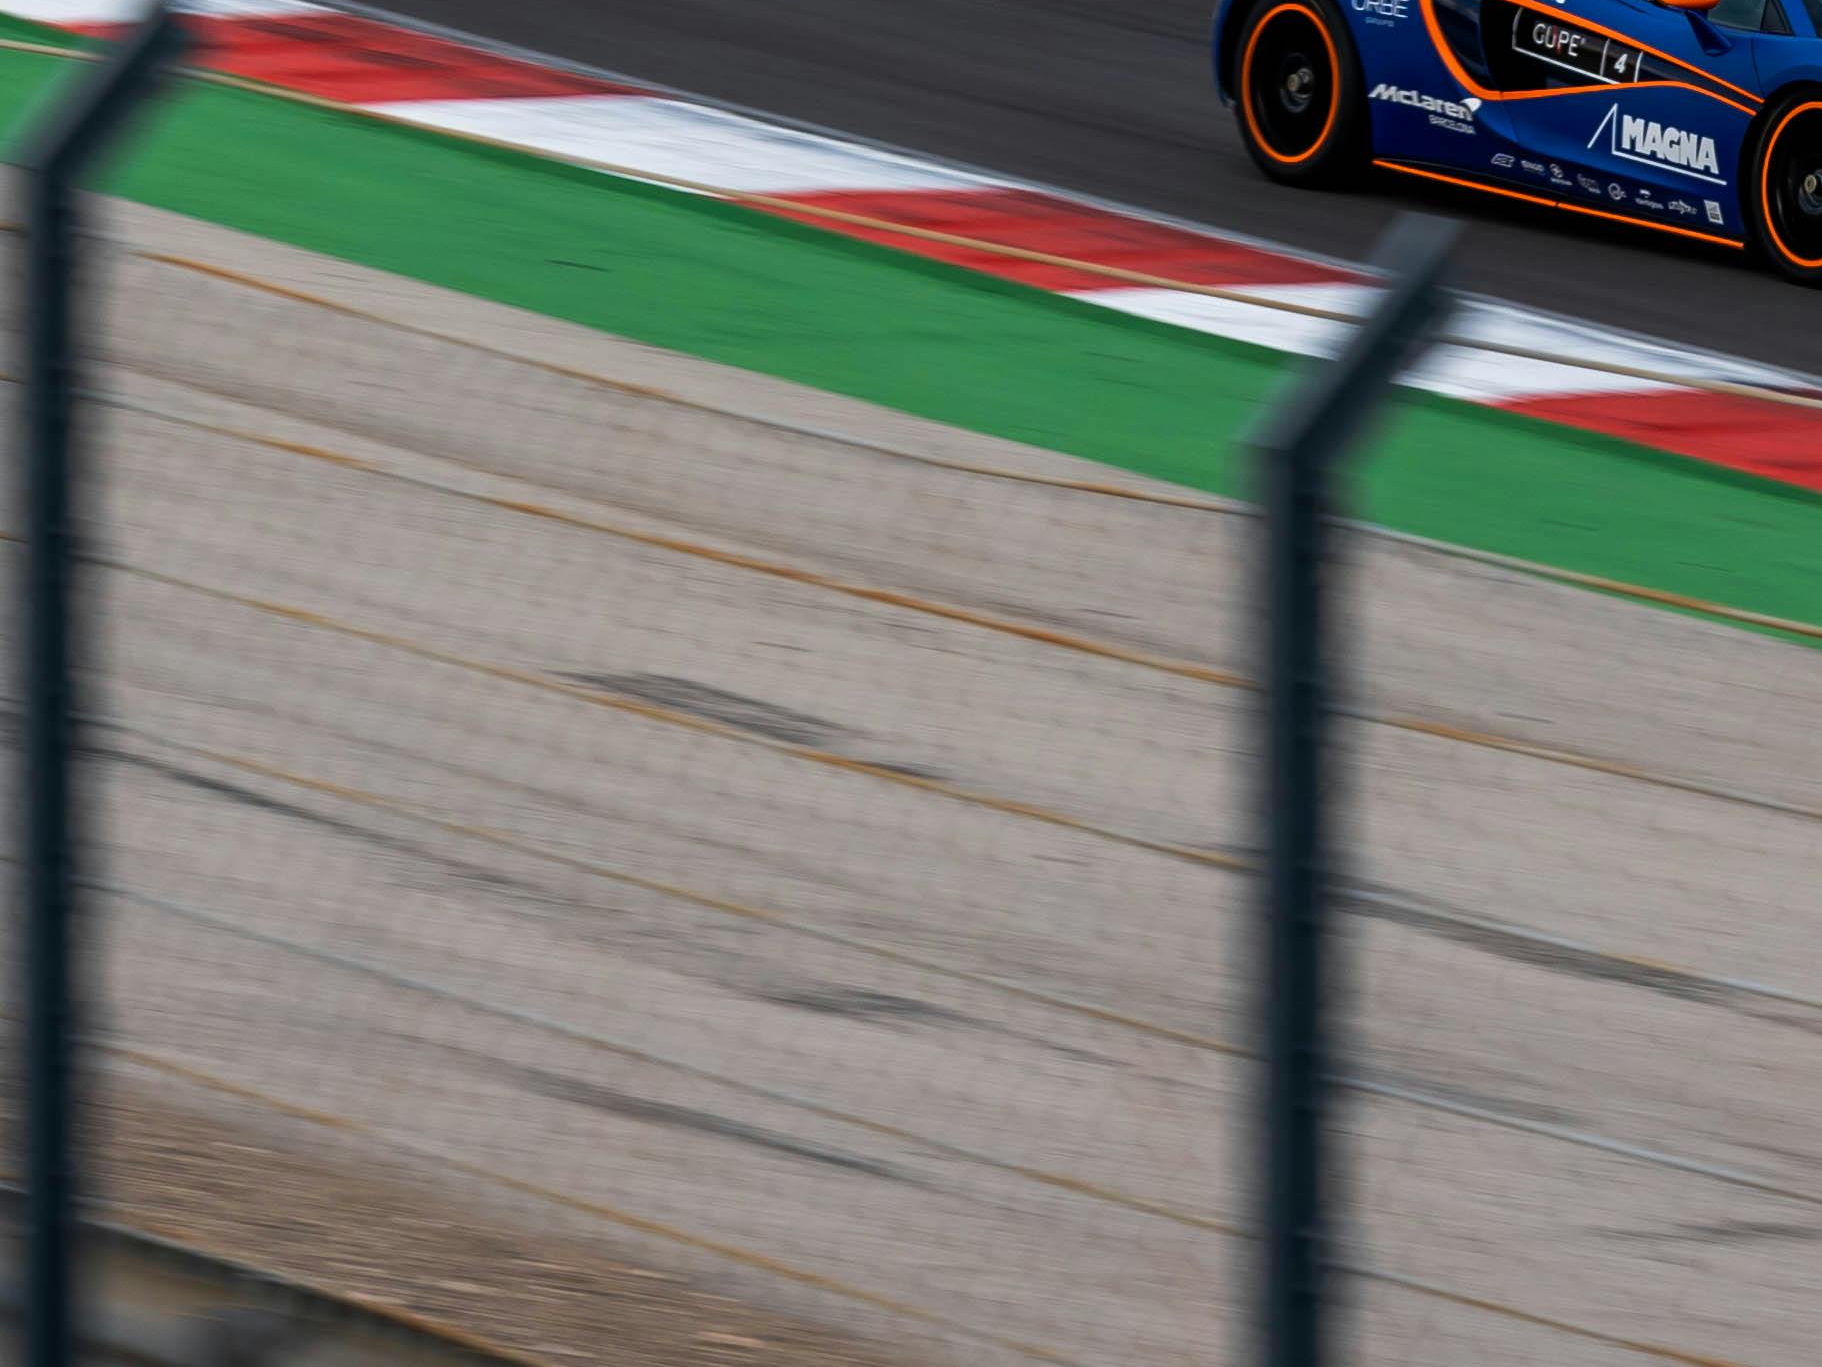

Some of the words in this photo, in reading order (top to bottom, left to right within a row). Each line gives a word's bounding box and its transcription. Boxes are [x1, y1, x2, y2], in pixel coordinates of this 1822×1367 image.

[1613, 53, 1629, 74] 4
[1367, 83, 1476, 122] McLaren
[1621, 114, 1720, 175] MAGNA
